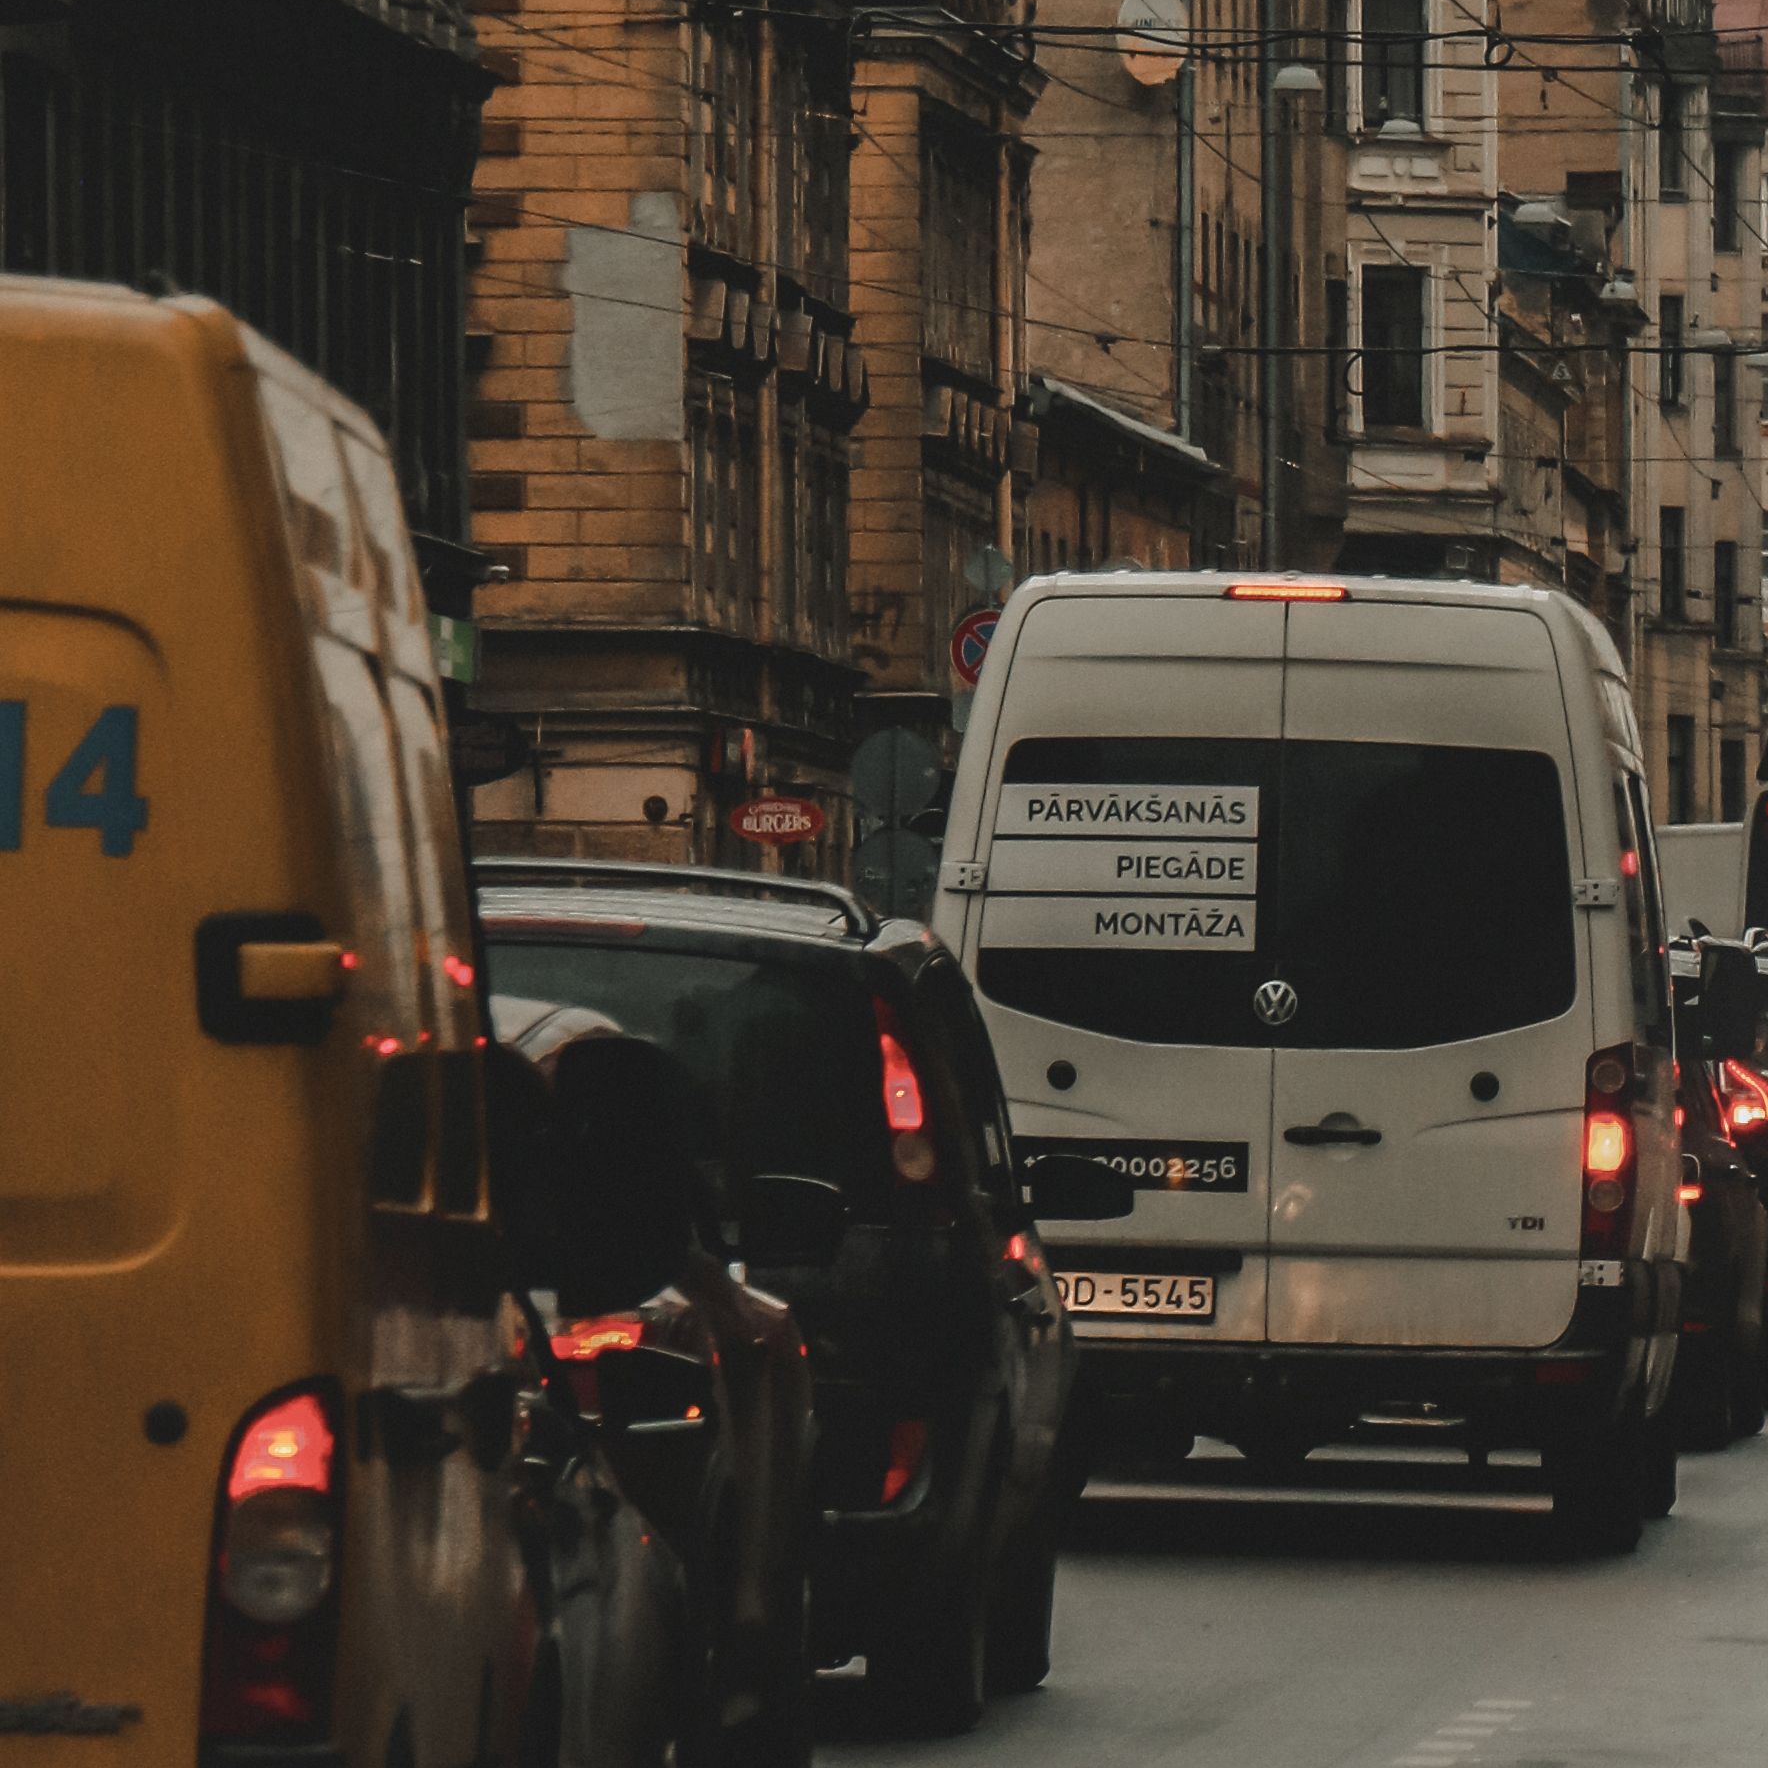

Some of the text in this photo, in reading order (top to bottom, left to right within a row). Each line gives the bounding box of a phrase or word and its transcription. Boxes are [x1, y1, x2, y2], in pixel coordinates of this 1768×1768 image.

[742, 813, 812, 834] BURGERS
[1028, 793, 1246, 825] PĀRVĀKŠANĀS
[1116, 851, 1246, 880] PIEGĀDE
[1095, 908, 1245, 938] MONTĀŽA
